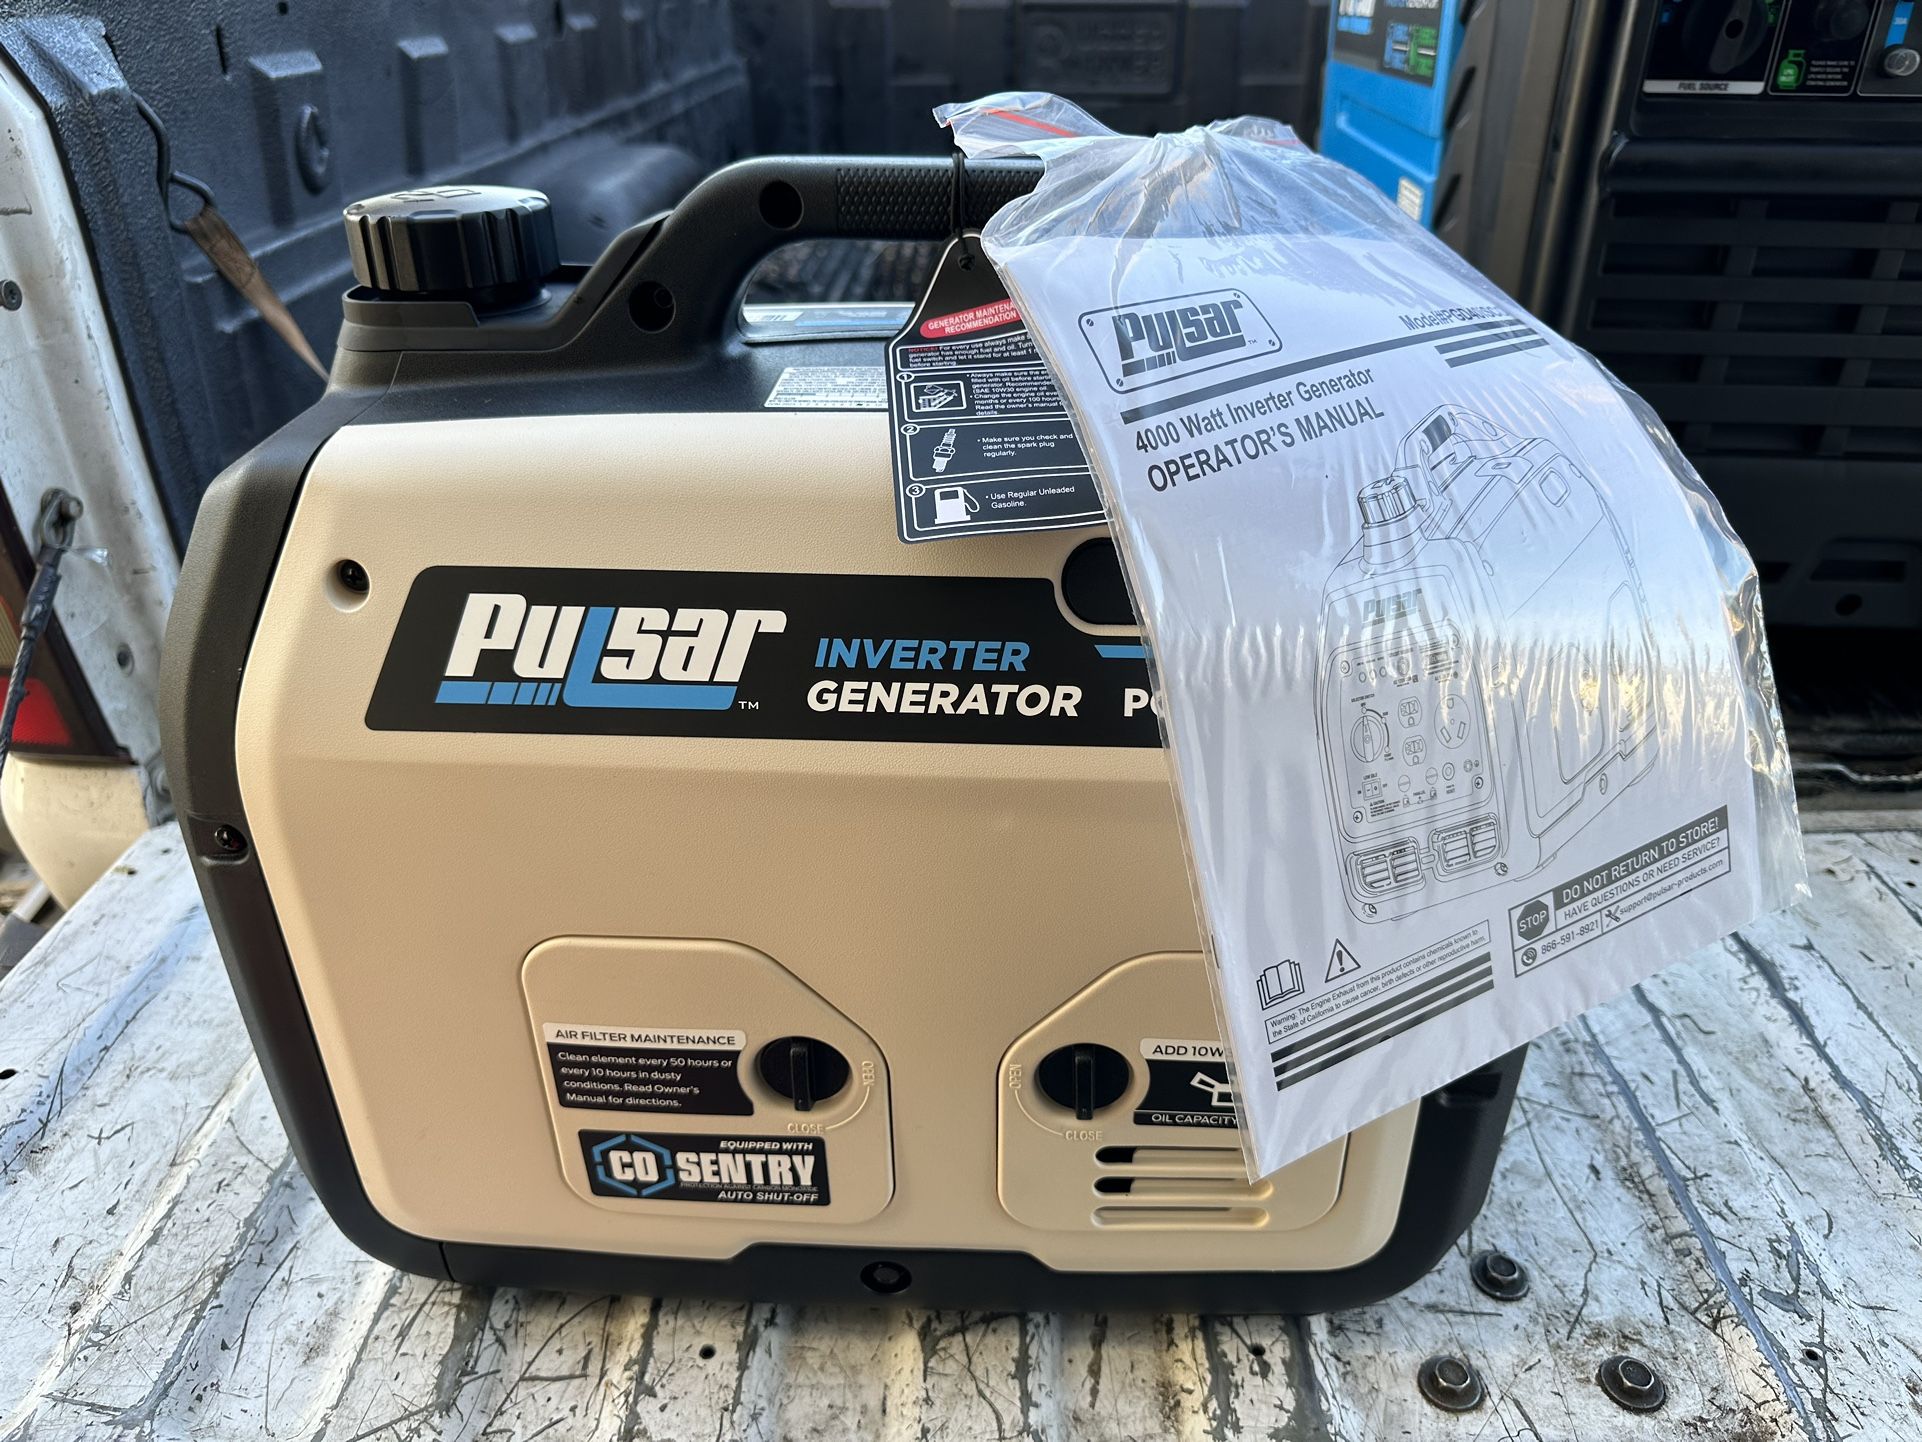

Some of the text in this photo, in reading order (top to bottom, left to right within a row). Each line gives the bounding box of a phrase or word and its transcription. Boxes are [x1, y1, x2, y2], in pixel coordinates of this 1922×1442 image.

[928, 303, 1015, 330] GENERATOR MAINTENA
[945, 310, 1016, 334] RECOMMENDATION
[1112, 299, 1246, 362] Pulsar
[984, 339, 1006, 348] always
[1008, 335, 1026, 344] make
[909, 351, 940, 359] generator
[955, 348, 979, 356] enough
[1010, 348, 1027, 356] least
[1135, 367, 1375, 454] 4000 Watt Inverter Generator
[983, 450, 1017, 458] regularly.
[1017, 441, 1037, 449] spark
[1039, 441, 1055, 449] plug
[1148, 396, 1386, 493] OPERATOR'S MANUAL
[912, 486, 920, 495] 3
[990, 486, 1075, 500] Use Regular Unleaded
[991, 500, 1027, 509] Gasoline.
[444, 592, 788, 711] Pulsar TM
[814, 637, 1030, 672] INVERTER
[806, 680, 1083, 717] GENERATOR
[1124, 688, 1158, 717] P
[1562, 816, 1720, 904] DO NOT RETURN TO STORE!
[1563, 836, 1720, 921] HAVE QUESTIONS OR NEED SERVICE?
[1619, 857, 1723, 915] support@pulsar-products.com
[1519, 909, 1547, 933] STOP
[1541, 919, 1600, 955] 866-591-8921
[1270, 1011, 1298, 1028] Warning:
[1298, 1006, 1310, 1016] The
[1310, 996, 1332, 1013] Engine
[1332, 986, 1356, 1001] Exhaust
[1356, 978, 1370, 989] from
[1369, 974, 1381, 984] this
[1381, 963, 1402, 979] product
[1402, 955, 1426, 970] contains
[1426, 941, 1454, 958] chemicals
[1453, 932, 1472, 944] known
[1272, 1029, 1282, 1038] the
[1283, 1022, 1299, 1033] State
[1300, 1017, 1307, 1026] of
[1306, 1006, 1335, 1023] California
[1341, 995, 1360, 1007] cause
[1360, 985, 1381, 998] cancer,
[1381, 978, 1395, 989] birth
[1395, 969, 1415, 983] defects
[1415, 965, 1422, 973] or
[1422, 959, 1437, 970] other
[1437, 943, 1470, 963] reproductive
[1470, 936, 1486, 948] harm.
[555, 1029, 736, 1046] AIR FILTER MAINTENANCE
[558, 1051, 590, 1062] Clean
[591, 1054, 637, 1065] element
[638, 1058, 669, 1068] every
[670, 1057, 686, 1067] 50
[687, 1058, 720, 1068] hours
[1152, 1045, 1224, 1057] ADD 10W
[561, 1067, 682, 1082] every 10 hours in dusty
[862, 1061, 875, 1087] OPEN
[1008, 1064, 1022, 1089] OPEN
[563, 1080, 700, 1095] conditions. Read Owner's
[566, 1093, 682, 1107] Manual for directions.
[787, 1123, 824, 1134] CLOSE
[1151, 1113, 1237, 1125] OIL CAPACITY
[720, 1140, 813, 1150] EQUIPPED WITH
[1065, 1130, 1103, 1141] CLOSE
[608, 1150, 815, 1186] CO SENTRY
[718, 1190, 819, 1202] AUTO SHUT-OFF
